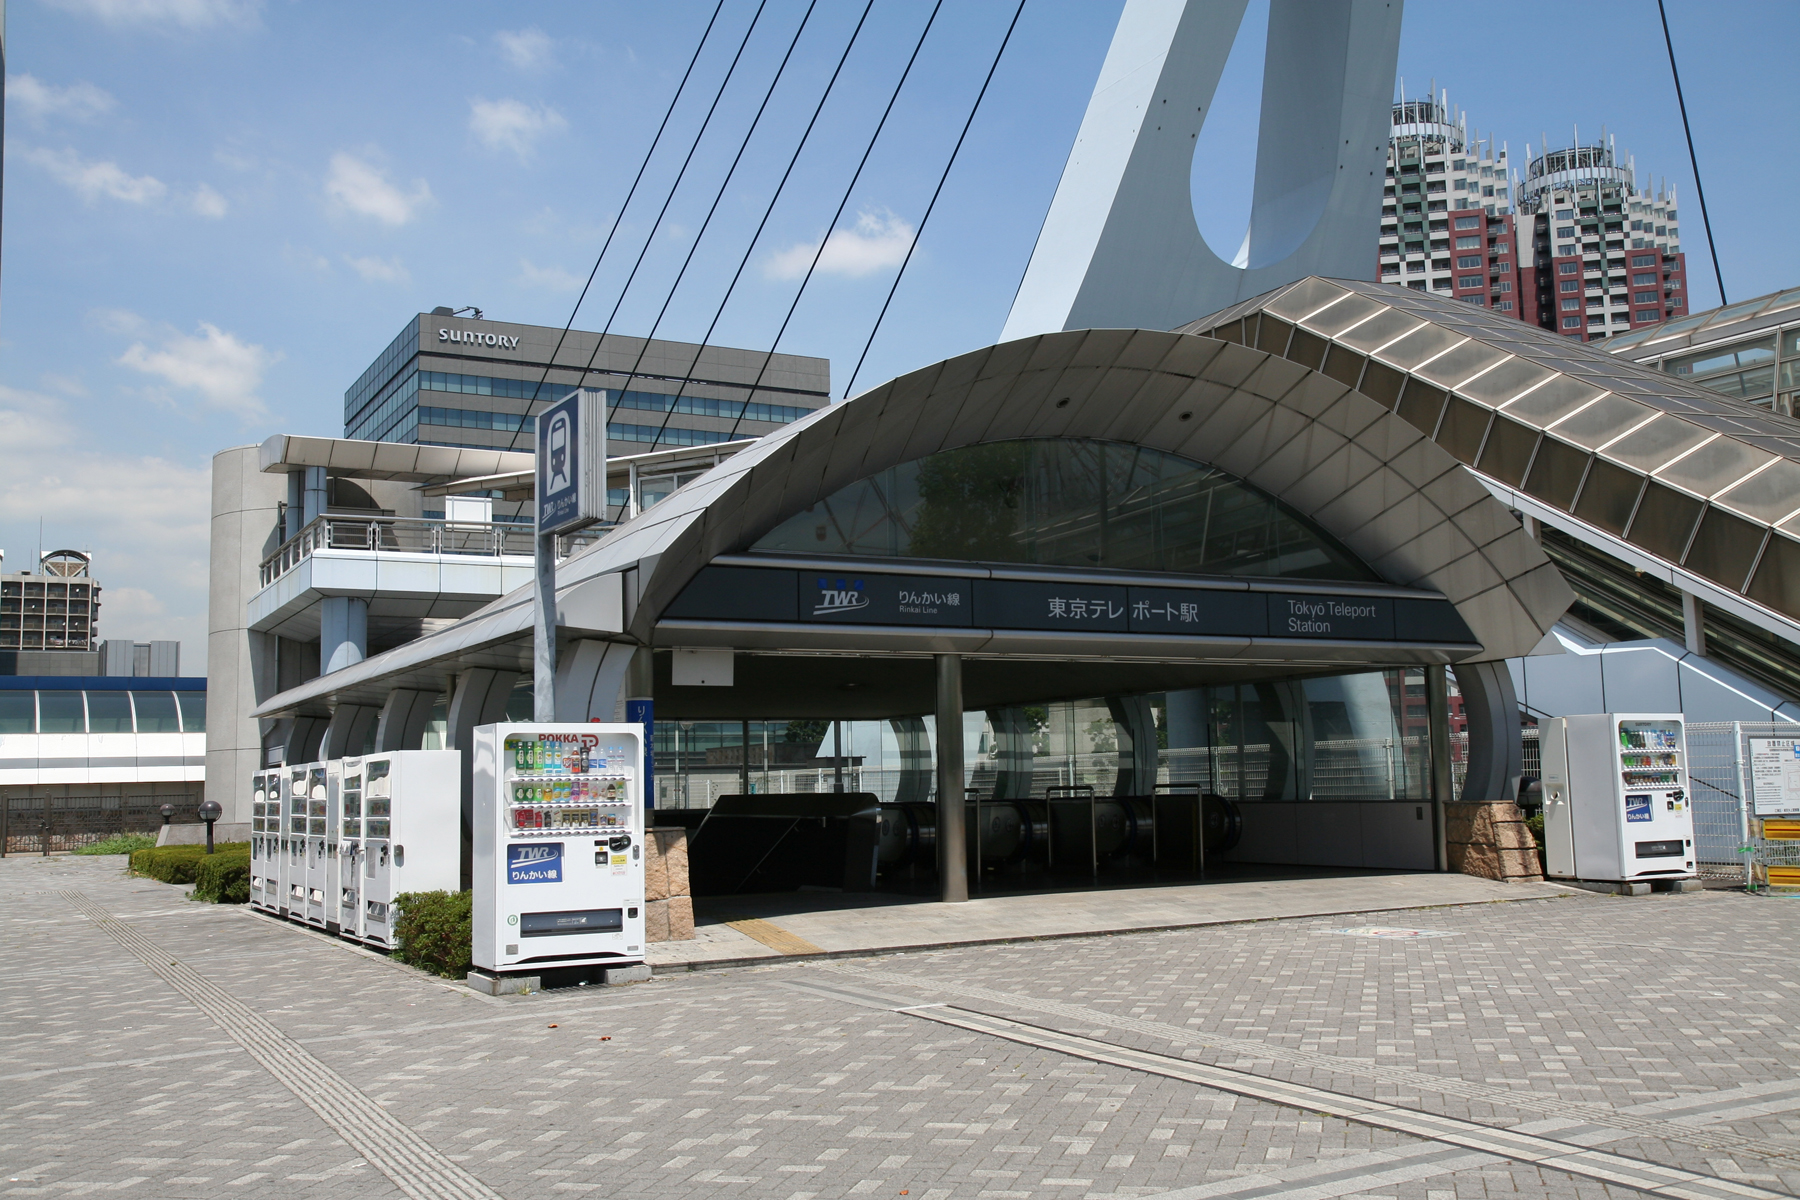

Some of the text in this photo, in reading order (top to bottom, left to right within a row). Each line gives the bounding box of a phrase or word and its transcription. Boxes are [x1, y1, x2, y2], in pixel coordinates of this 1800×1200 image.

[899, 590, 960, 606] りんかい線
[899, 605, 938, 614] Rinkai Line
[1048, 597, 1199, 622] 東京テレポート駅
[1327, 602, 1376, 620] Teleport
[1288, 617, 1331, 632] Station
[538, 733, 579, 743] POKKA
[512, 869, 558, 880] りんかい線
